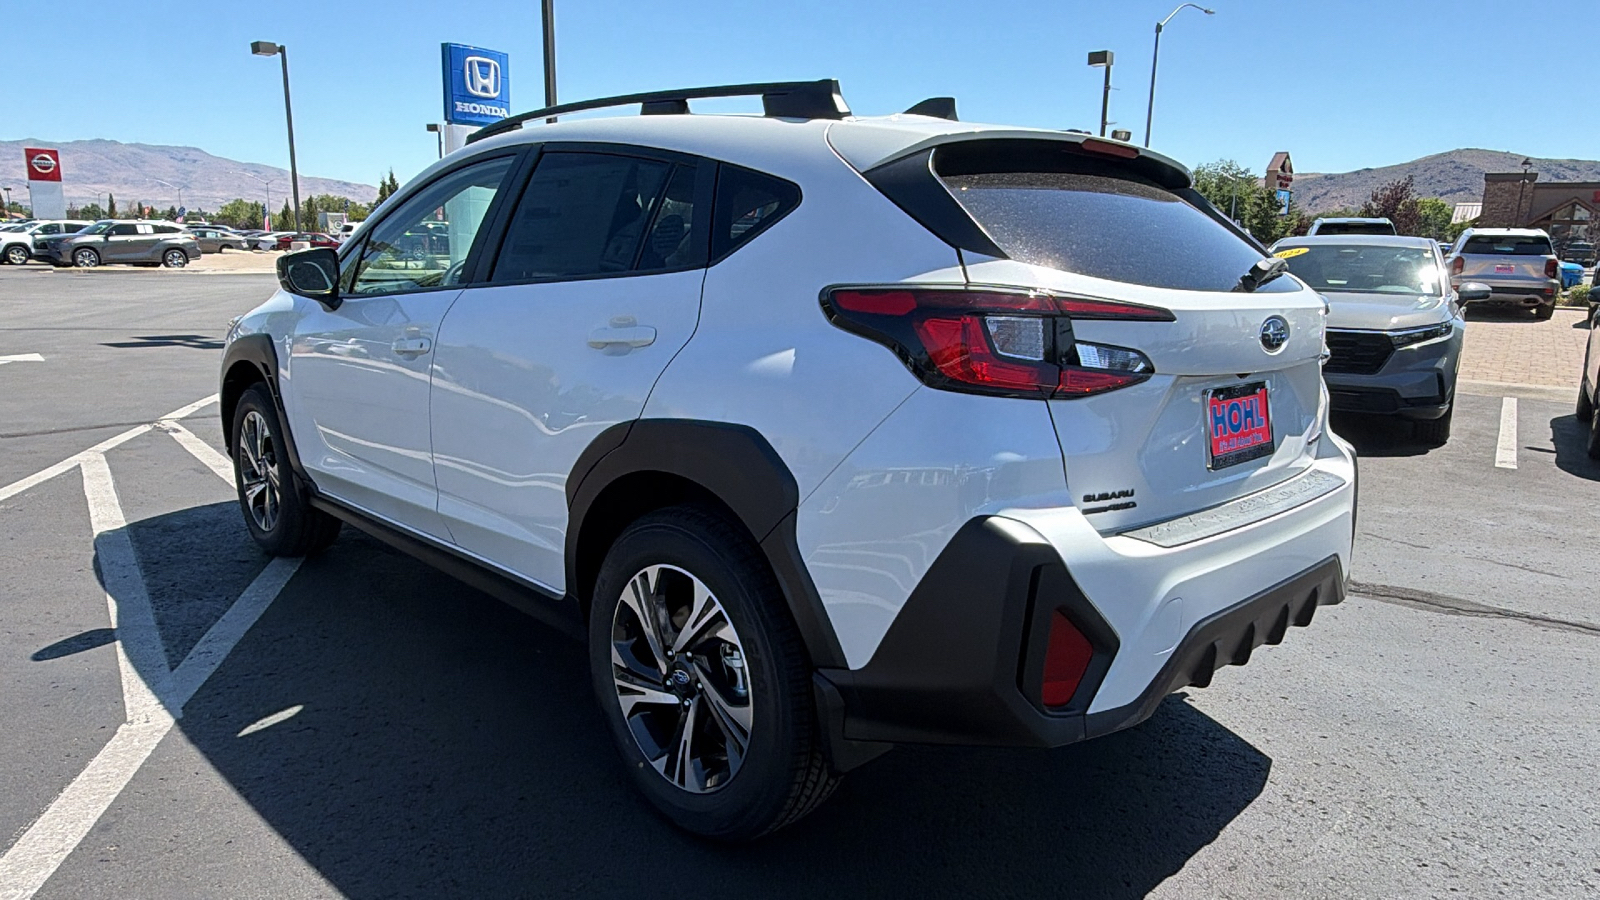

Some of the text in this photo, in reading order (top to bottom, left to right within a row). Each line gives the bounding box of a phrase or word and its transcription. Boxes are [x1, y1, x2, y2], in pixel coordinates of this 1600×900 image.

[454, 101, 510, 118] HONDA
[1212, 398, 1265, 438] HOHL
[1229, 437, 1237, 449] All
[1083, 488, 1134, 502] SUBARU
